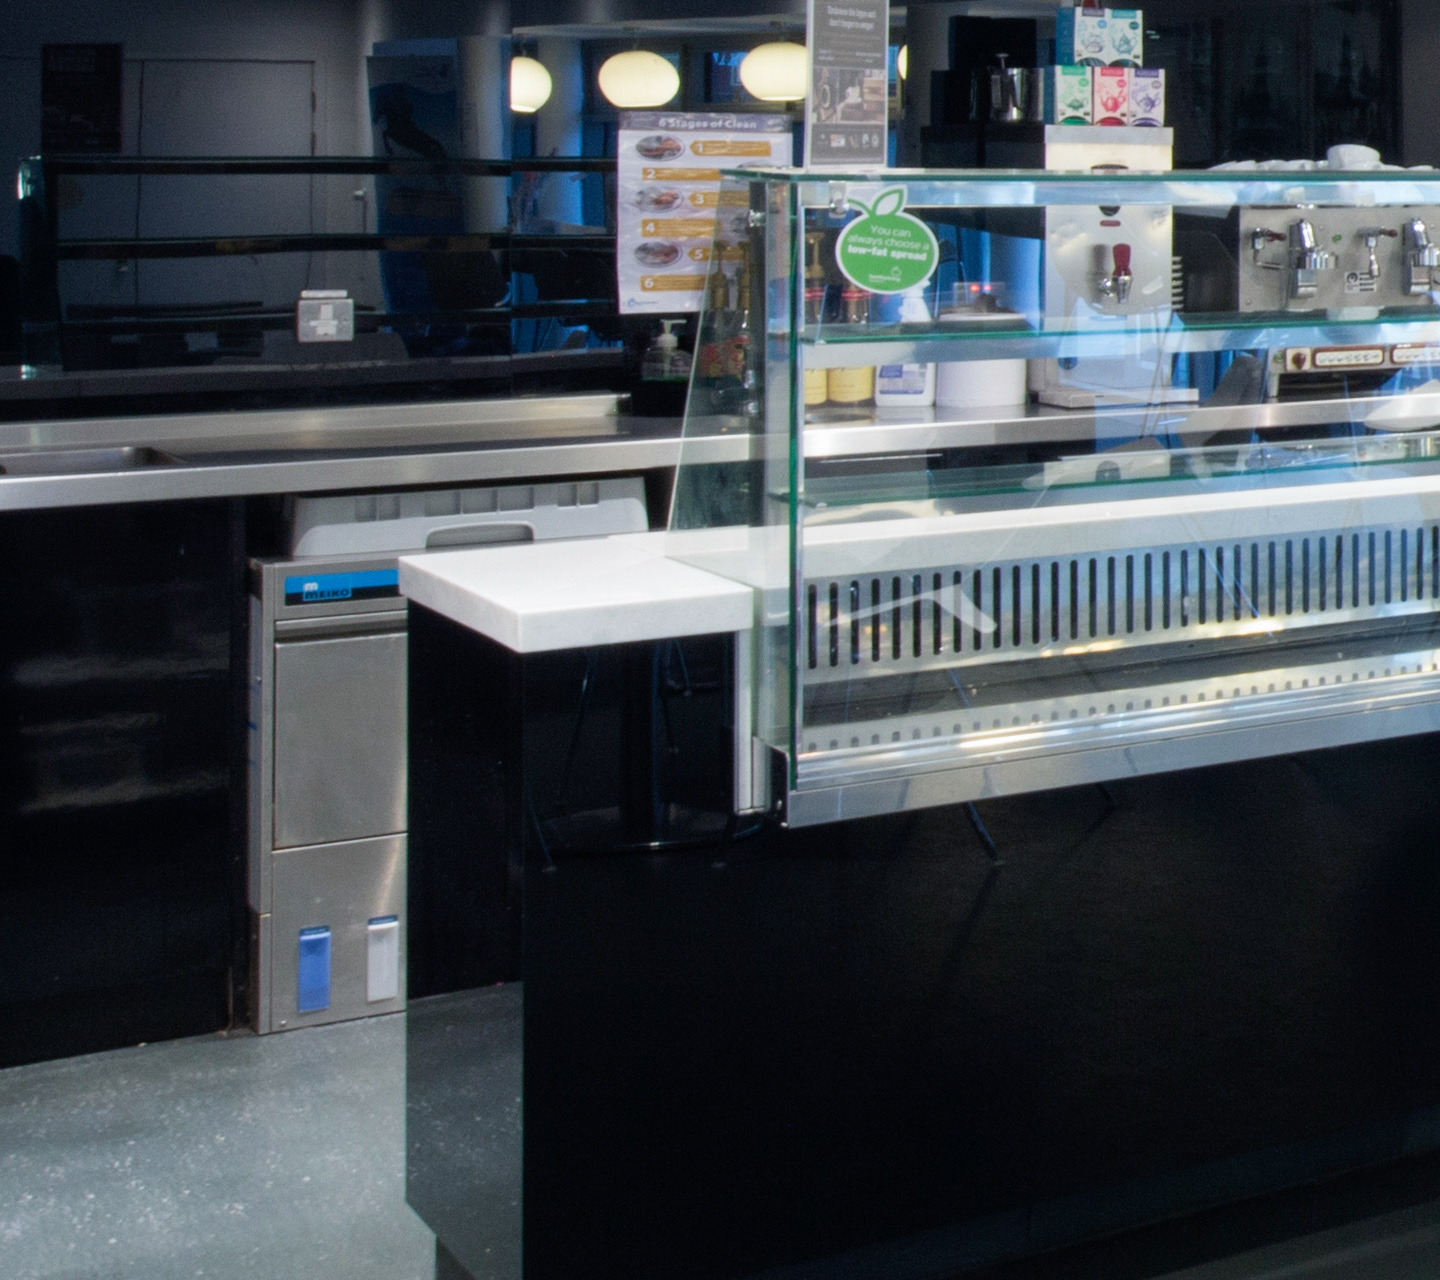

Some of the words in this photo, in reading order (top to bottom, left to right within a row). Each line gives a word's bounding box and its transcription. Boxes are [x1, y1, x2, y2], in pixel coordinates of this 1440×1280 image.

[666, 118, 707, 129] Stages
[710, 119, 721, 128] of
[725, 119, 757, 129] Clean
[697, 143, 704, 153] 1
[647, 169, 655, 179] 2
[696, 194, 704, 204] 3
[646, 222, 655, 232] 4
[870, 224, 891, 235] You
[892, 228, 911, 237] can
[847, 234, 882, 246] always
[884, 238, 921, 249] choose
[694, 249, 703, 259] 5
[848, 244, 887, 256] low-fat
[890, 250, 927, 261] spread
[645, 277, 654, 288] 6
[304, 588, 350, 600] MEIKO
